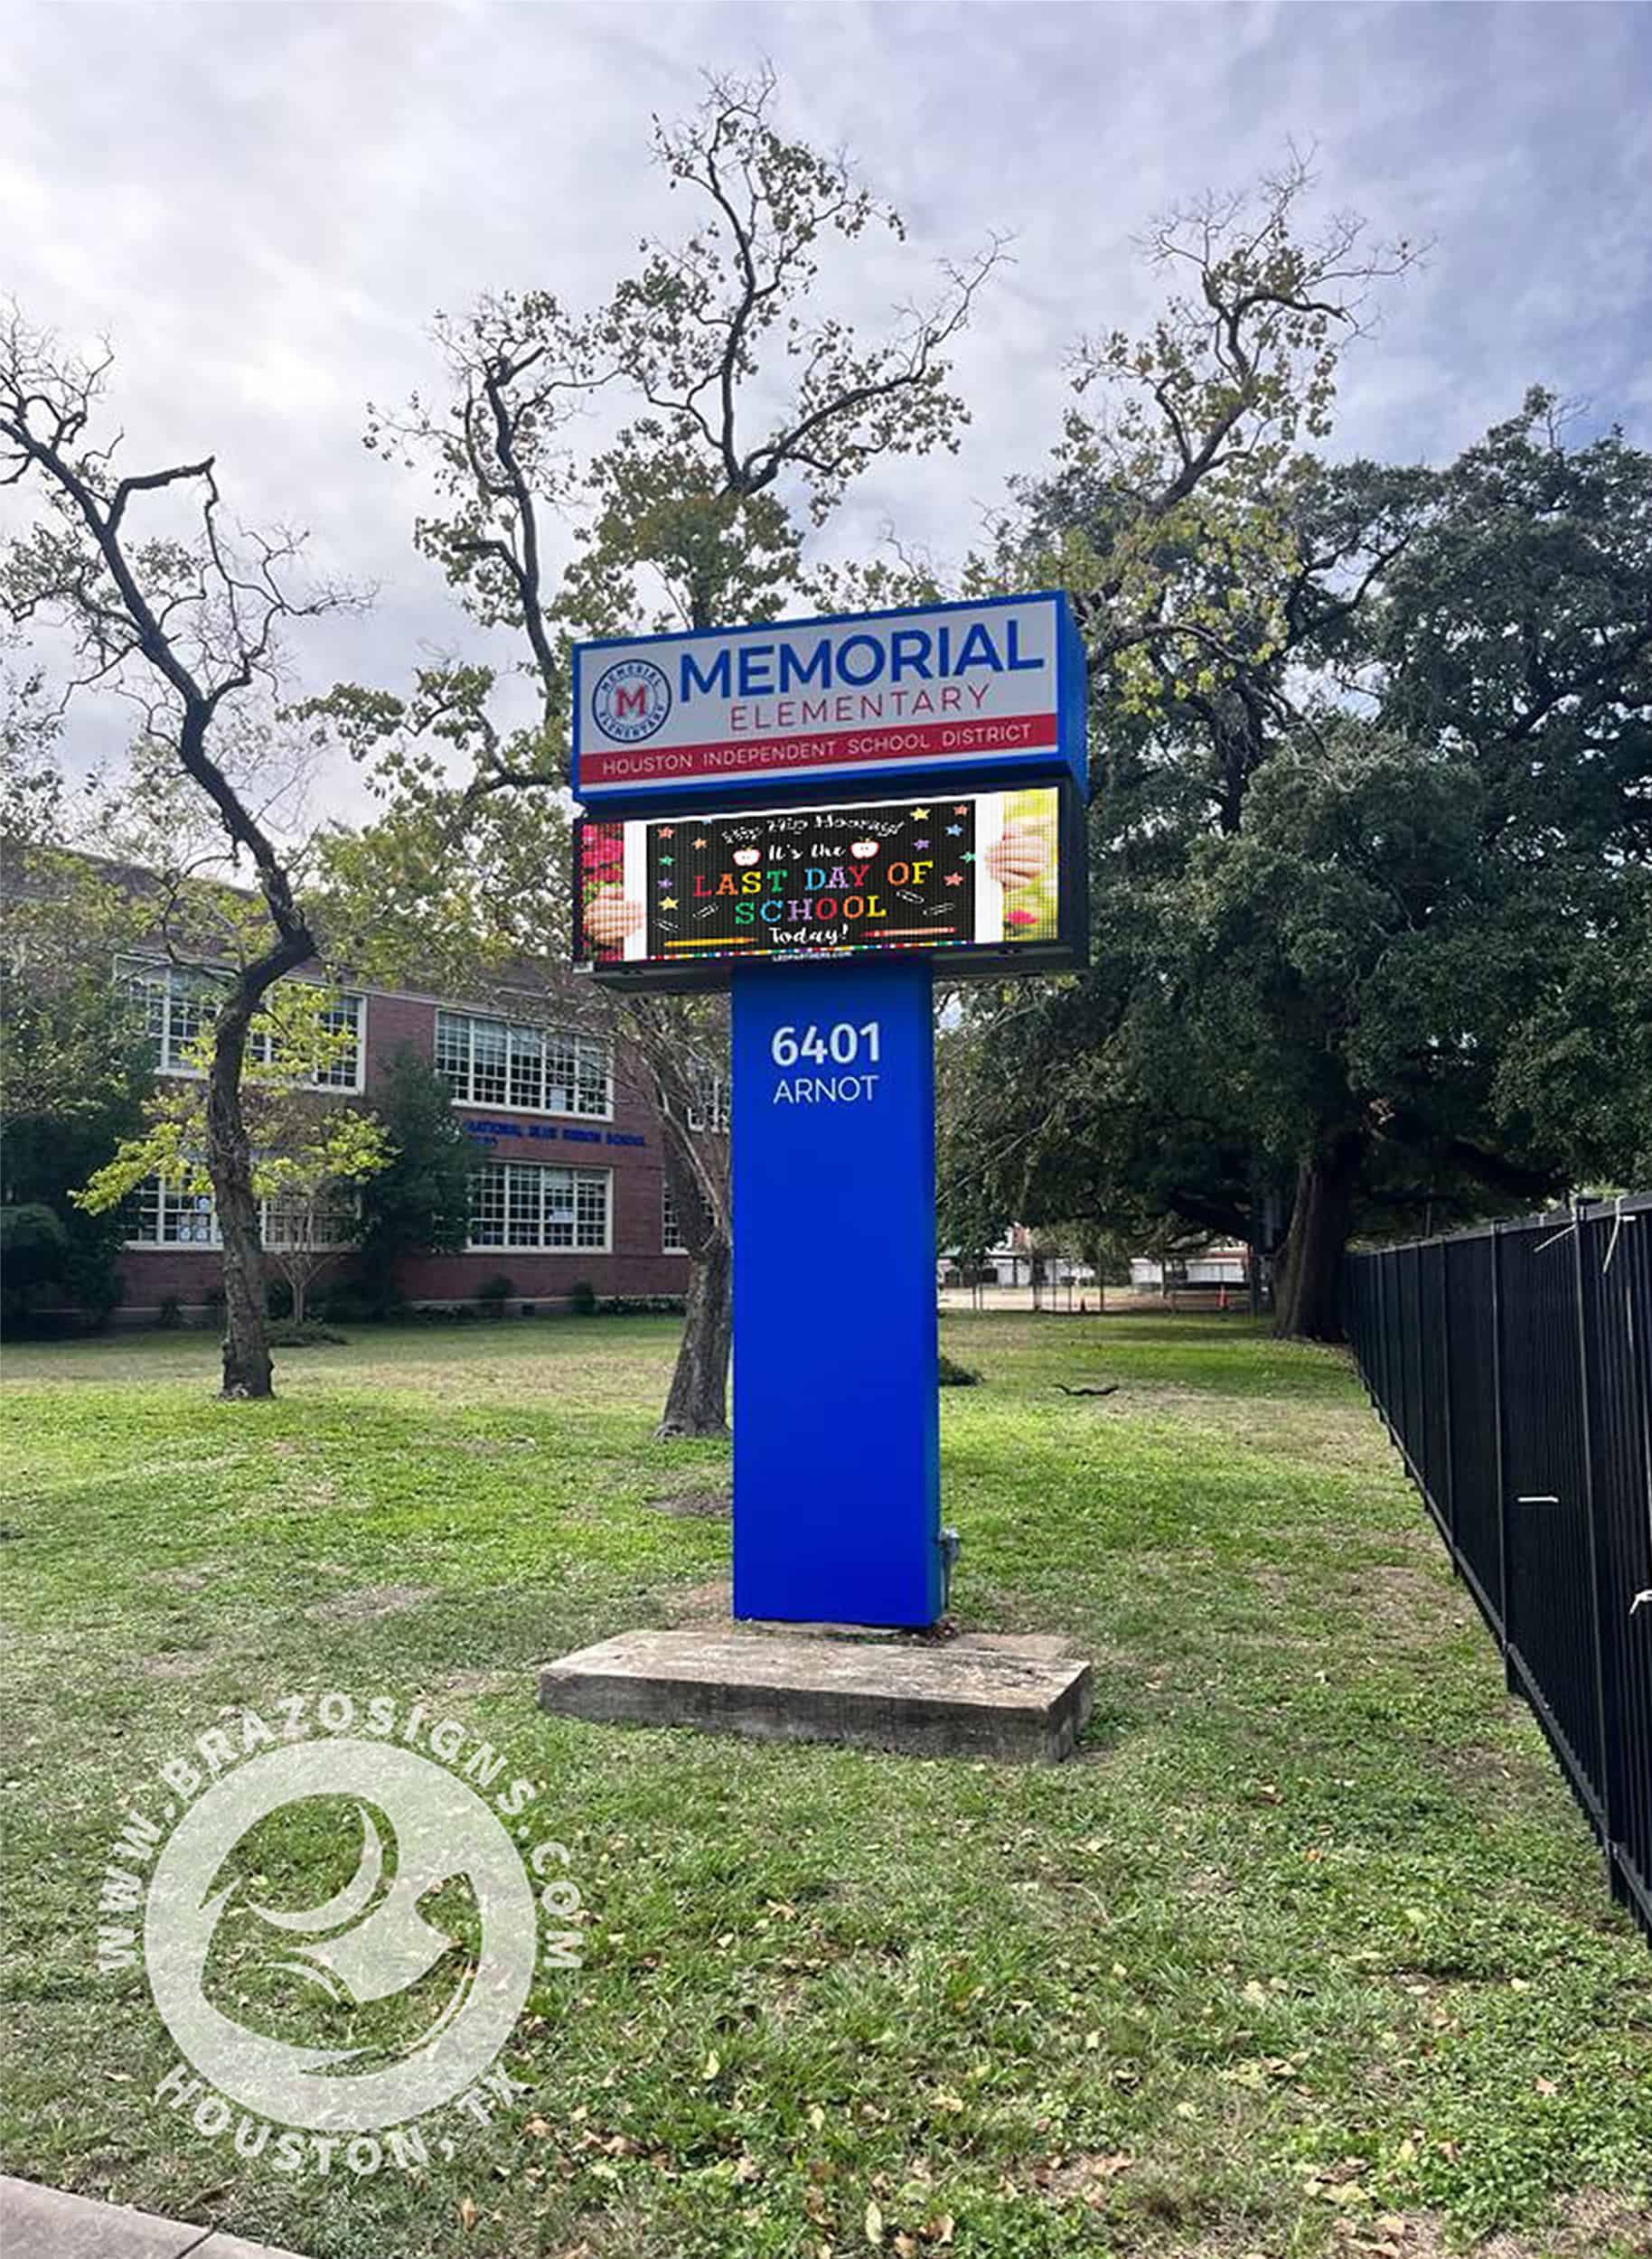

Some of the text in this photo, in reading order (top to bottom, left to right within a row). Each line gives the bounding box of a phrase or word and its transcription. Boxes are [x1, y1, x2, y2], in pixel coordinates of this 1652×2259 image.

[680, 619, 1045, 703] MEMORIAL
[615, 684, 646, 717] M
[730, 684, 991, 731] ELEMENTARY
[603, 724, 1031, 774] HOUSTON INDEPENDENT SCHOOL DISTRICT
[768, 843, 847, 861] It's the
[693, 860, 934, 897] LAST DAY OF
[735, 895, 887, 925] SCHOOL
[768, 923, 849, 946] Today!
[771, 1021, 880, 1066] 6401
[773, 1074, 880, 1104] ARNOT
